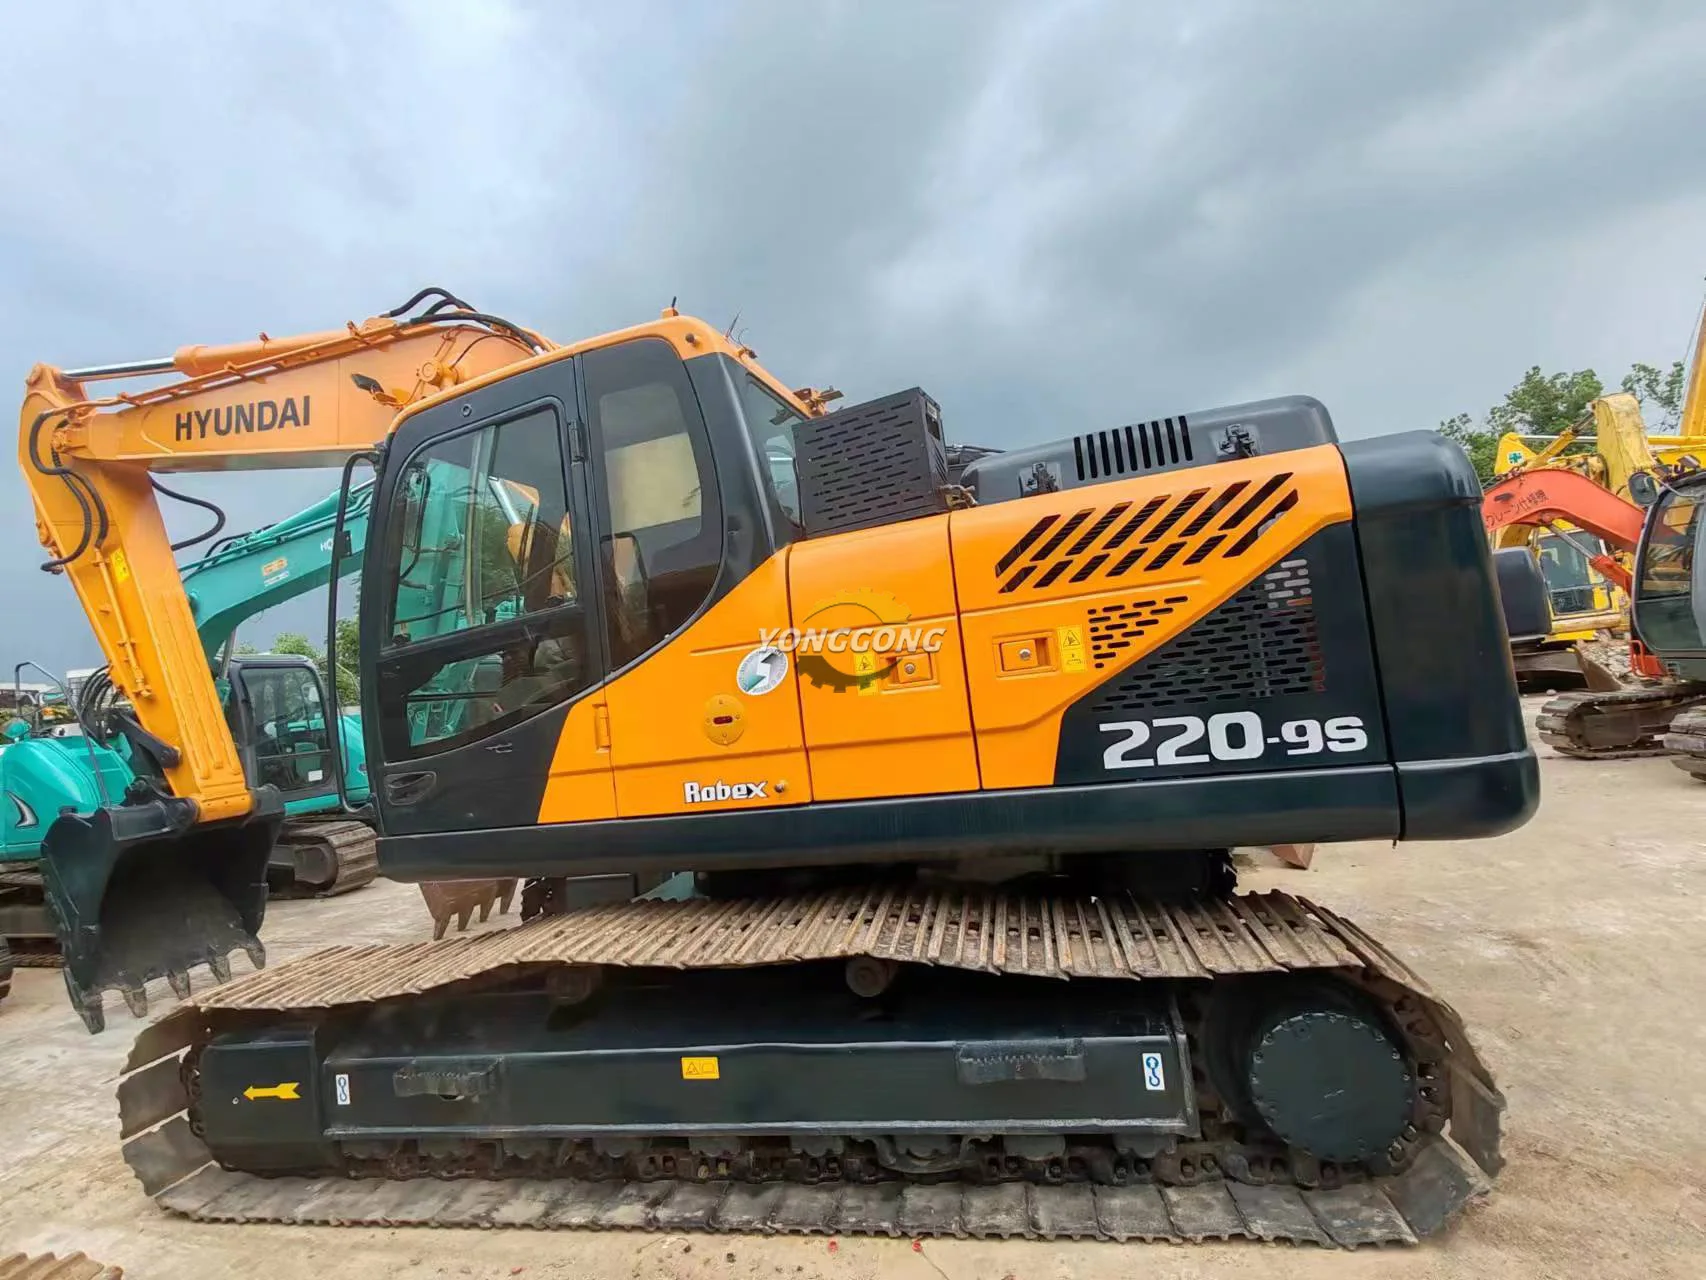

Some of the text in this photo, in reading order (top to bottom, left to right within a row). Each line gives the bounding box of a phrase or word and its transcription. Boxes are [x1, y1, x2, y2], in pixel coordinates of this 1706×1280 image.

[175, 395, 310, 441] HYUNDAI
[1099, 711, 1368, 769] 220-9S
[684, 780, 768, 803] Robex
